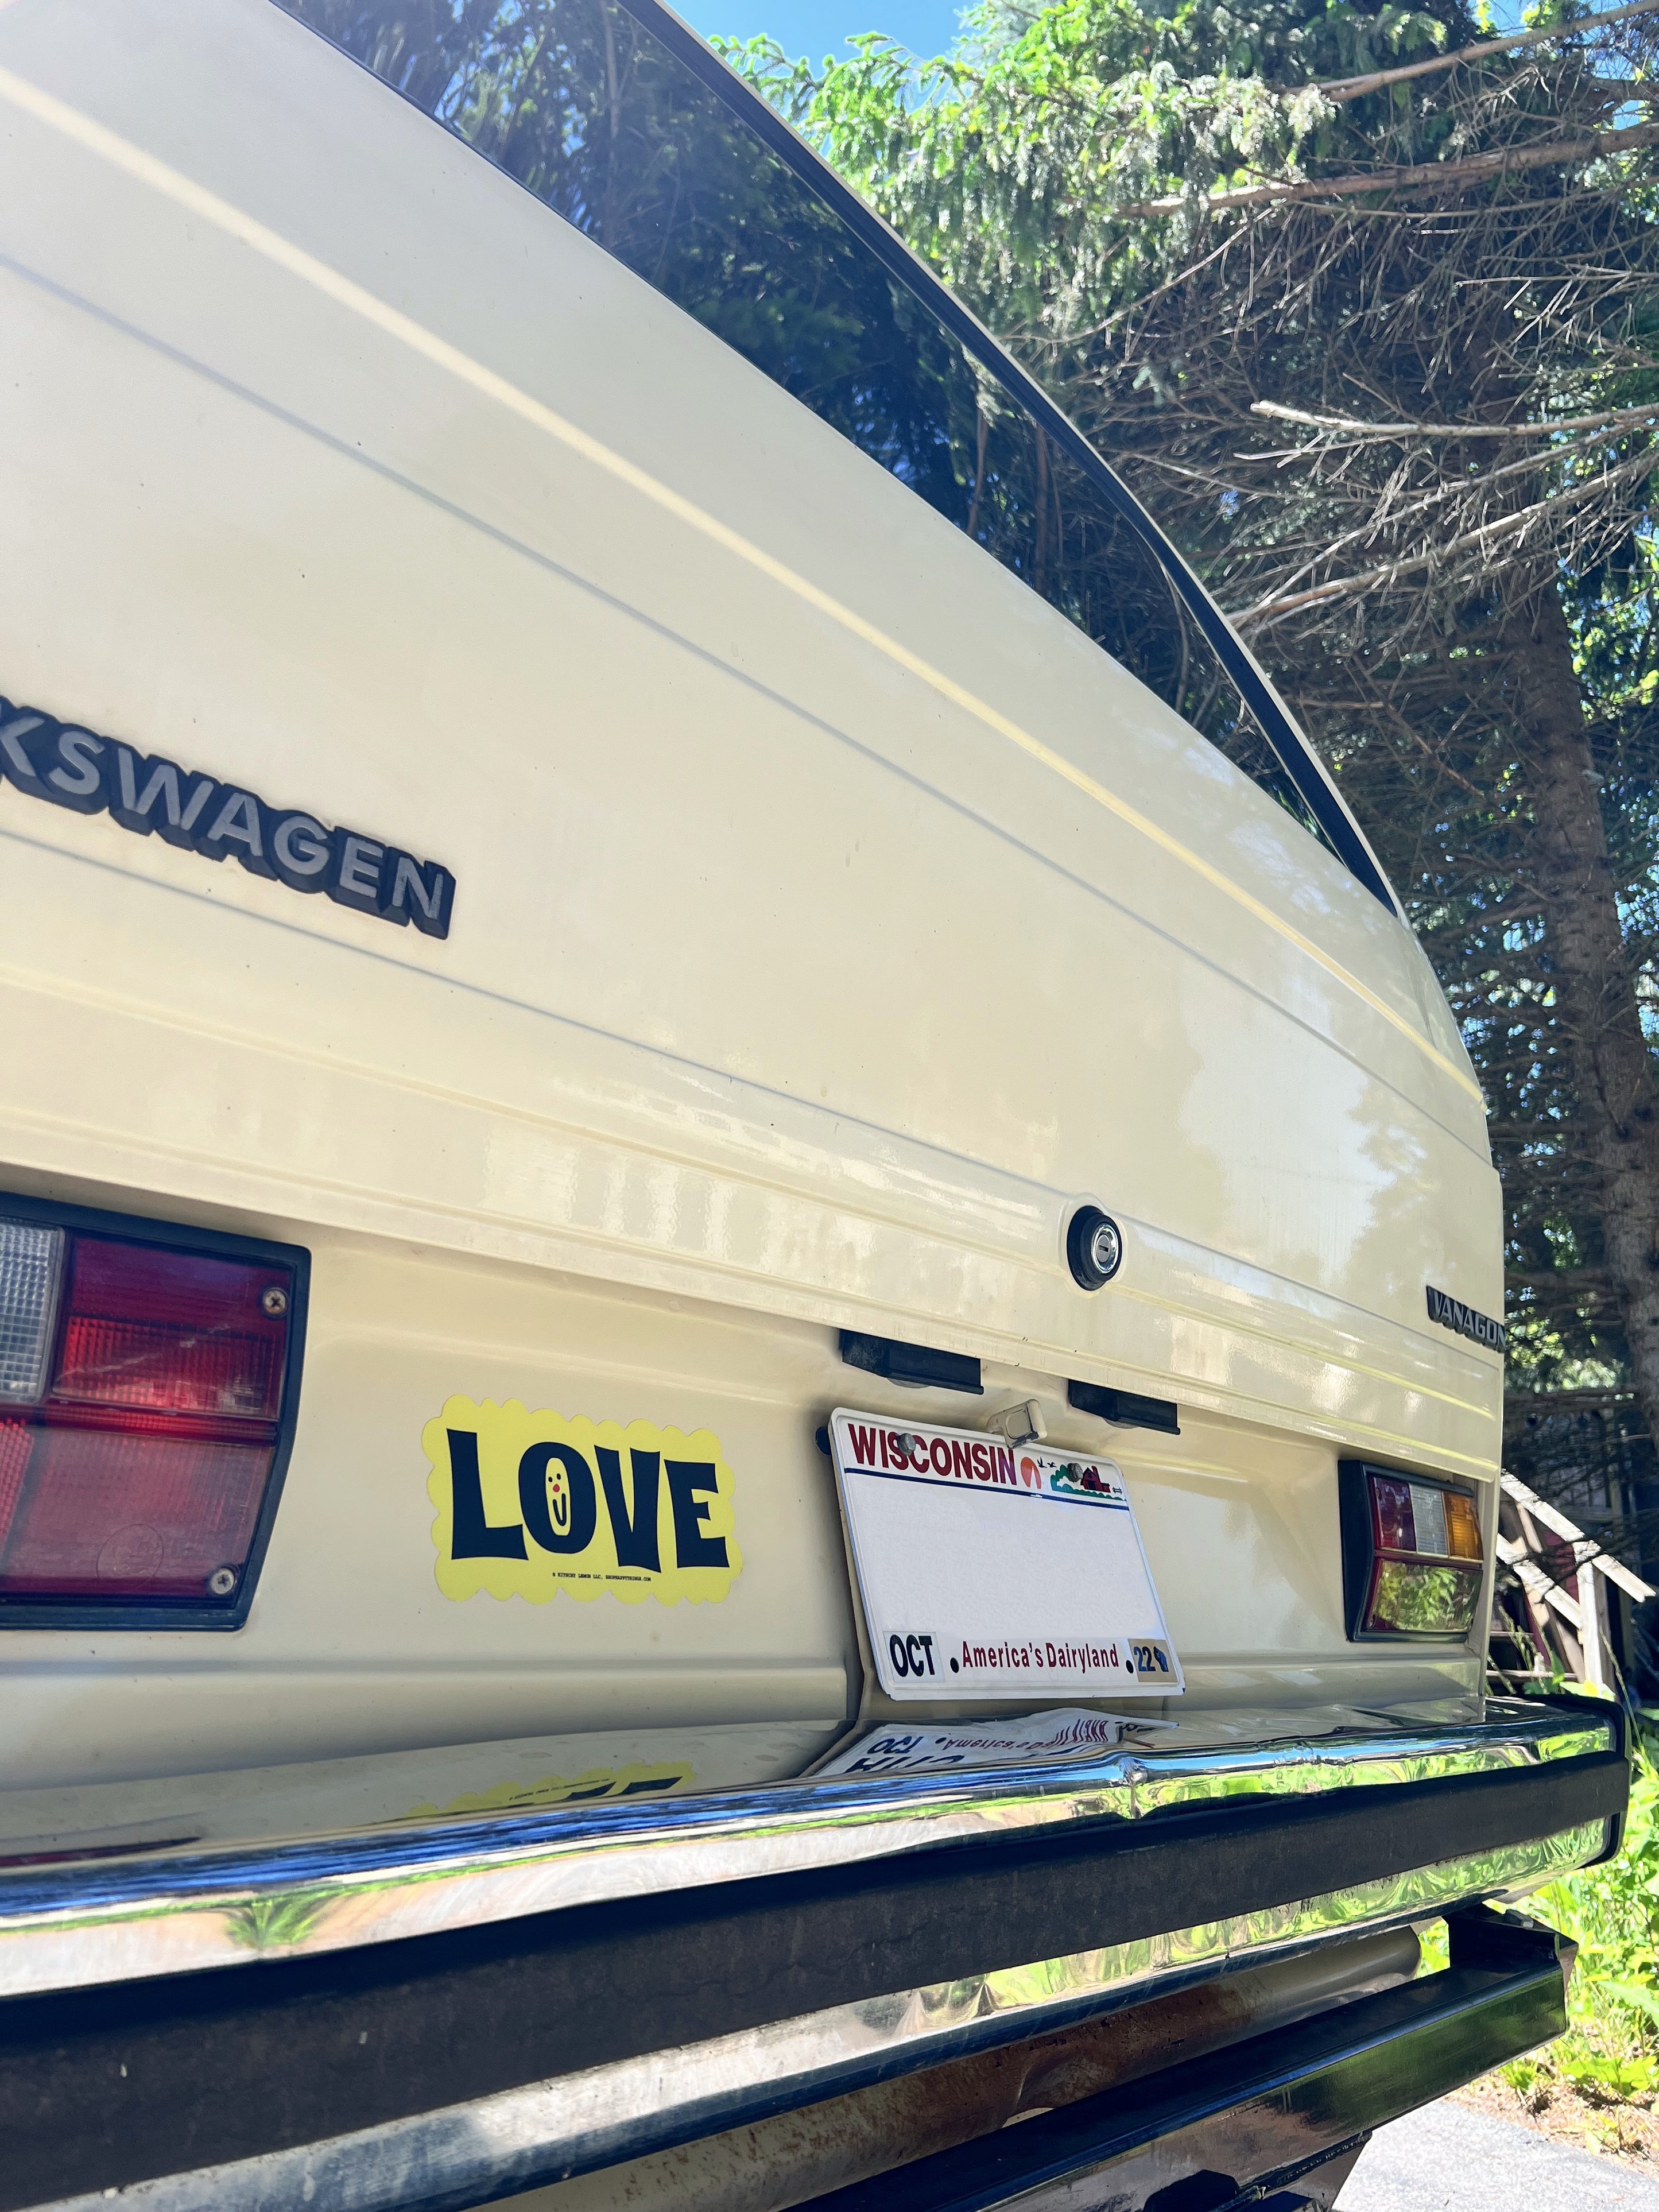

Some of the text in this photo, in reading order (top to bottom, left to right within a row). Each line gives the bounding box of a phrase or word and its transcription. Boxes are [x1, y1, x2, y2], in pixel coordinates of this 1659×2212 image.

[1433, 1289, 1507, 1351] VANAGON
[847, 1423, 1018, 1486] WISCONSIN
[445, 1427, 730, 1574] LOVE
[889, 1634, 934, 1677] OCT
[962, 1641, 1119, 1674] America's Dairyland
[1133, 1646, 1156, 1672] 22
